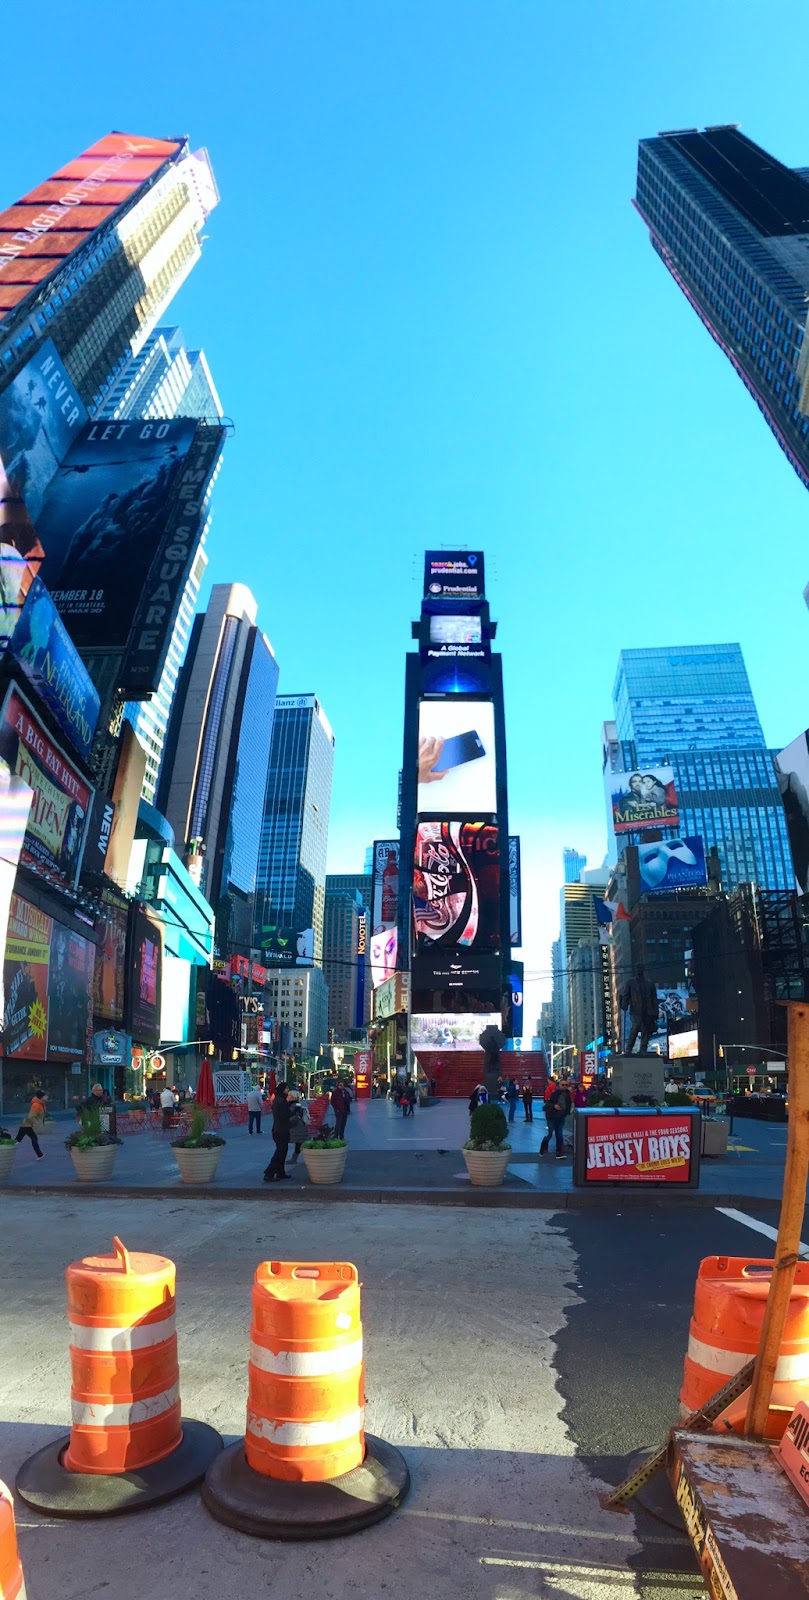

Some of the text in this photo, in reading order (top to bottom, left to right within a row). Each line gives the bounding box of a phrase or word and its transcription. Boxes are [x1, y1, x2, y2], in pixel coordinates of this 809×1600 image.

[11, 204, 71, 243] EAGLE
[59, 153, 134, 206] OUTFITTERS
[40, 355, 80, 428] NEVER
[87, 423, 170, 441] LET GO
[137, 442, 216, 650] TIMES SQUARE
[48, 589, 104, 602] TEMBER 18
[428, 650, 456, 658] Payment
[40, 651, 92, 746] NEVERLAND
[60, 659, 87, 711] FINDING
[45, 748, 62, 775] FAT
[26, 756, 65, 805] SOMETHING
[635, 803, 652, 812] Les
[97, 804, 114, 855] NEW
[667, 869, 705, 880] PHANTOM
[358, 913, 366, 955] NOVOTEL
[359, 1054, 369, 1074] tkts
[585, 1053, 595, 1075] tkts
[669, 1126, 689, 1134] SEASONS
[587, 1134, 690, 1169] JERSEY BOYS
